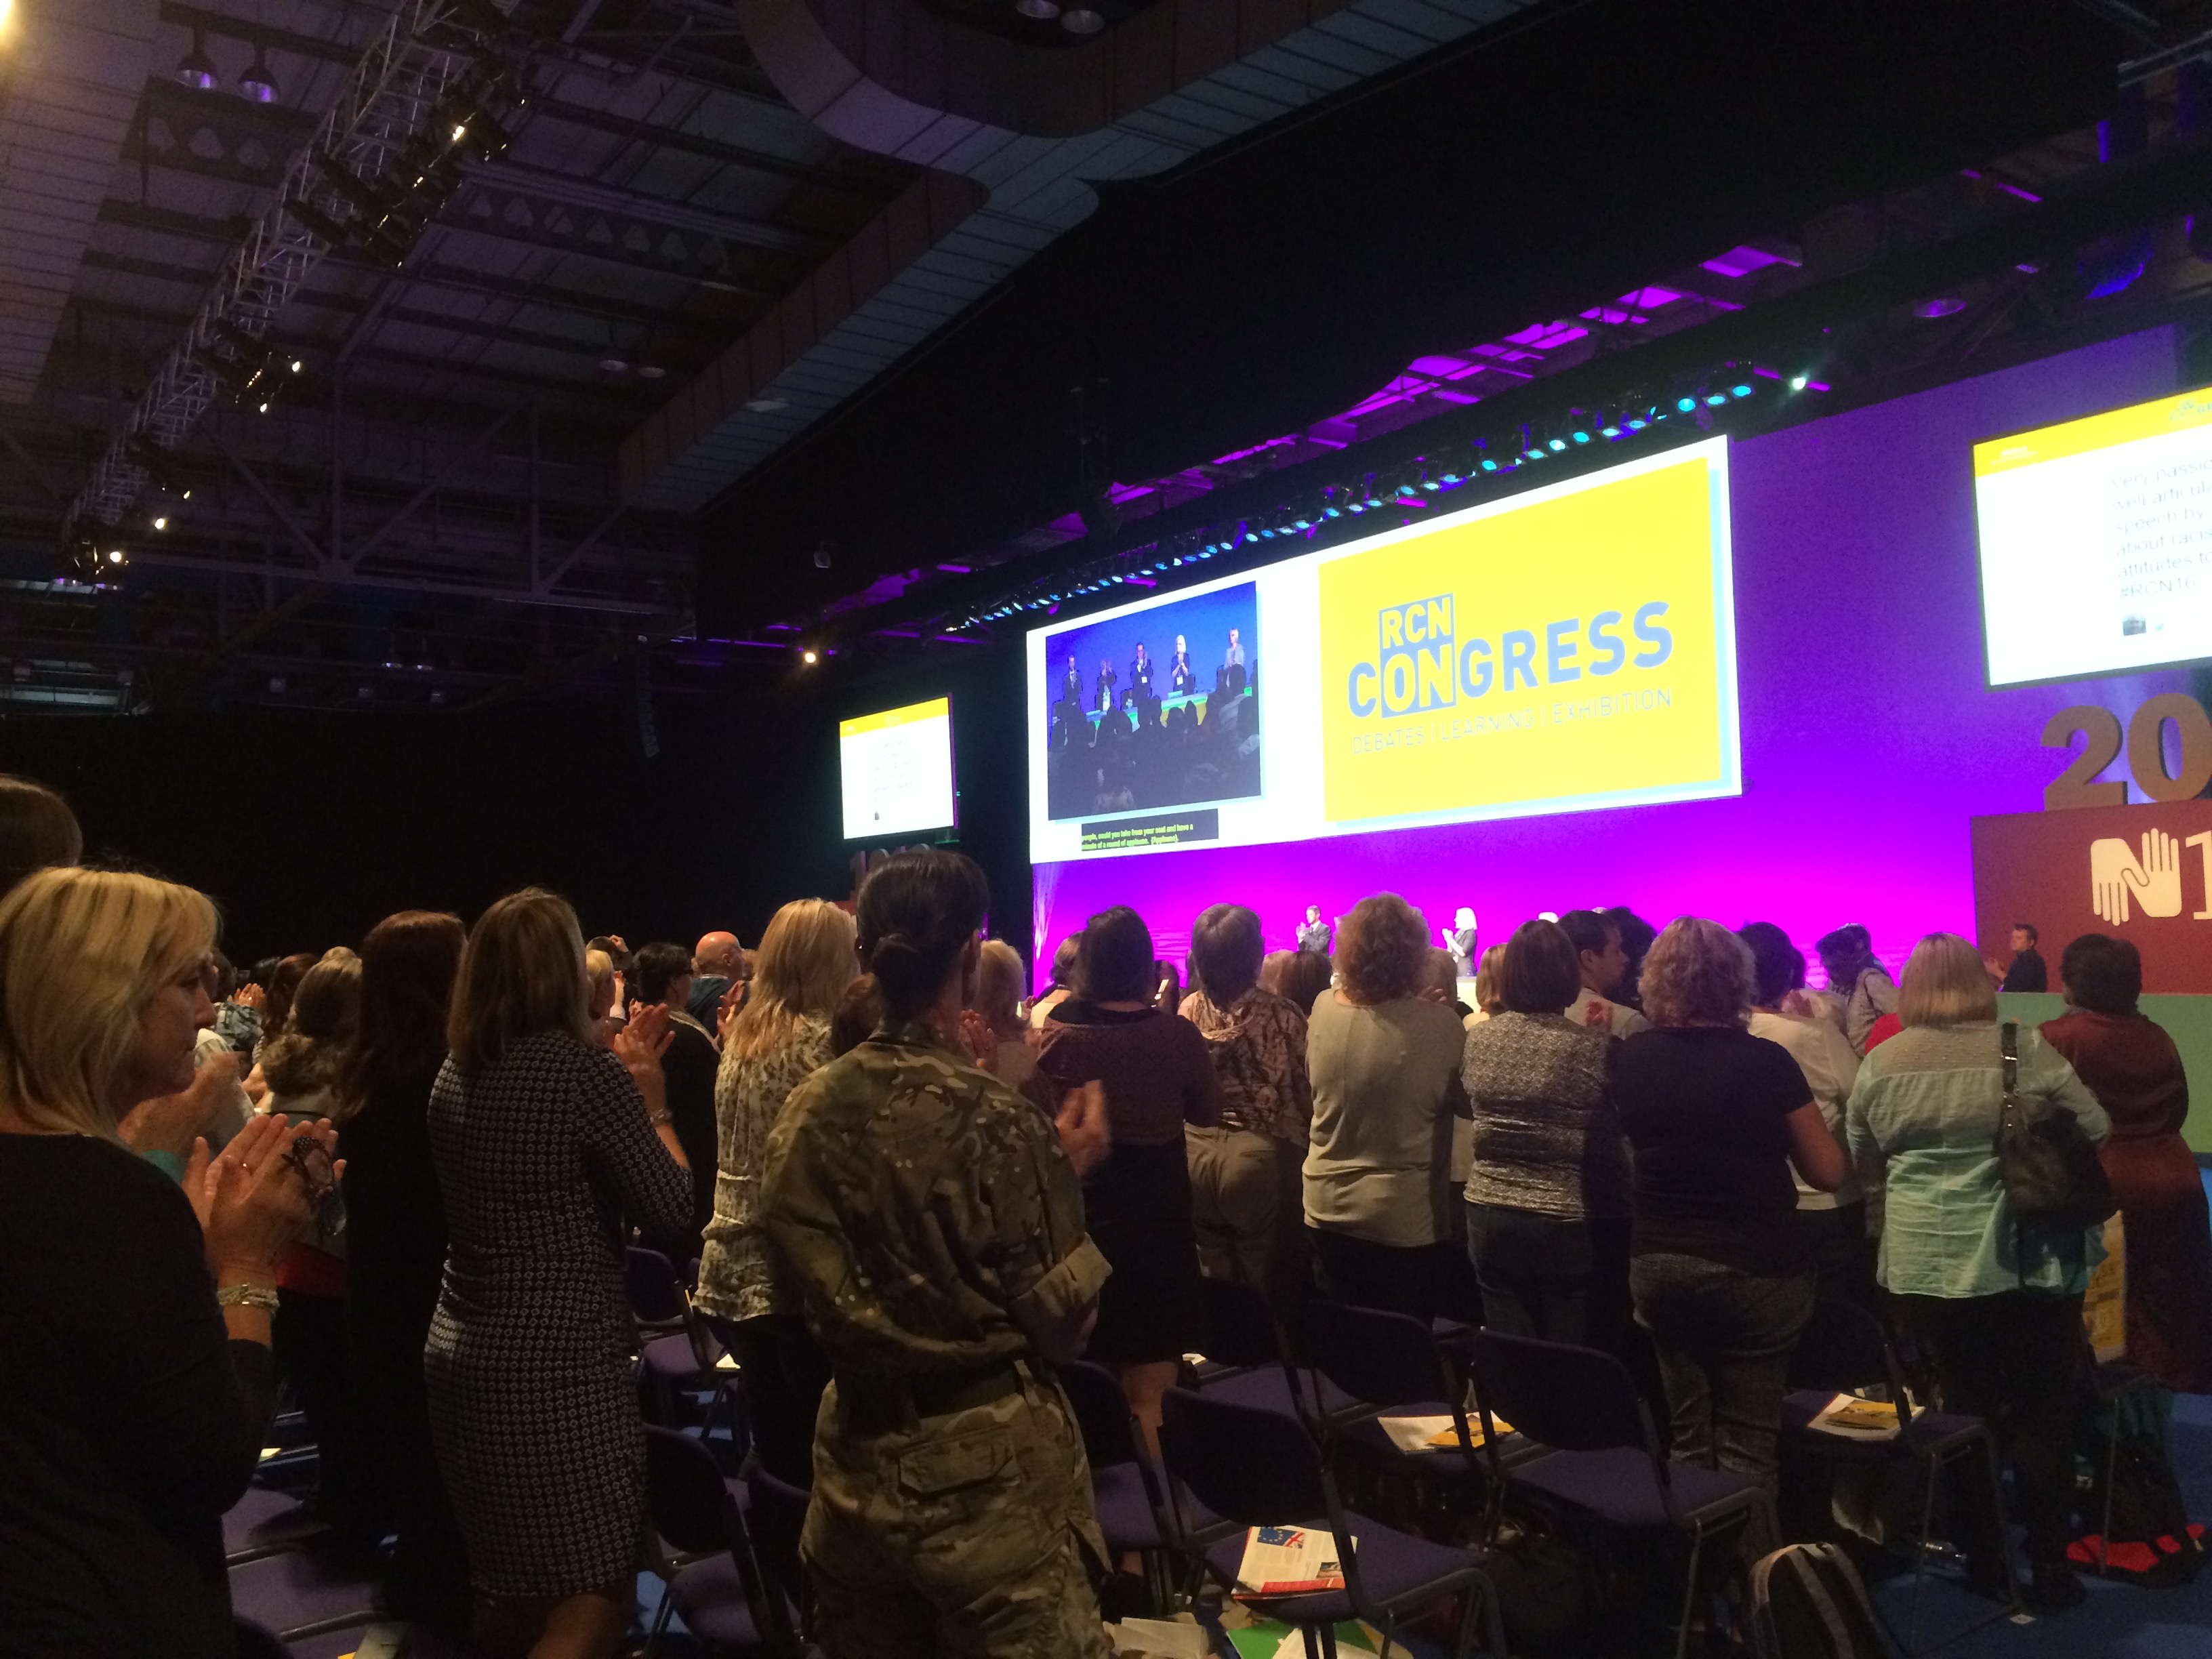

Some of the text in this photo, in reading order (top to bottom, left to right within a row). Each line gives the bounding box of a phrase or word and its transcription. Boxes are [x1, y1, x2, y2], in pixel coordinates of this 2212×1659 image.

[2110, 474, 2148, 489] Very
[2113, 493, 2146, 511] well
[2114, 506, 2205, 535] speech by
[2116, 535, 2165, 556] about
[2118, 555, 2193, 578] attitudes
[2120, 575, 2195, 598] #RCN16
[1382, 596, 1451, 650] RCN
[1348, 600, 1673, 718] CONGRESS
[1353, 725, 1425, 754] DEBATES
[1441, 708, 1534, 742] LEARNING
[1553, 687, 1672, 724] EXHIBITION
